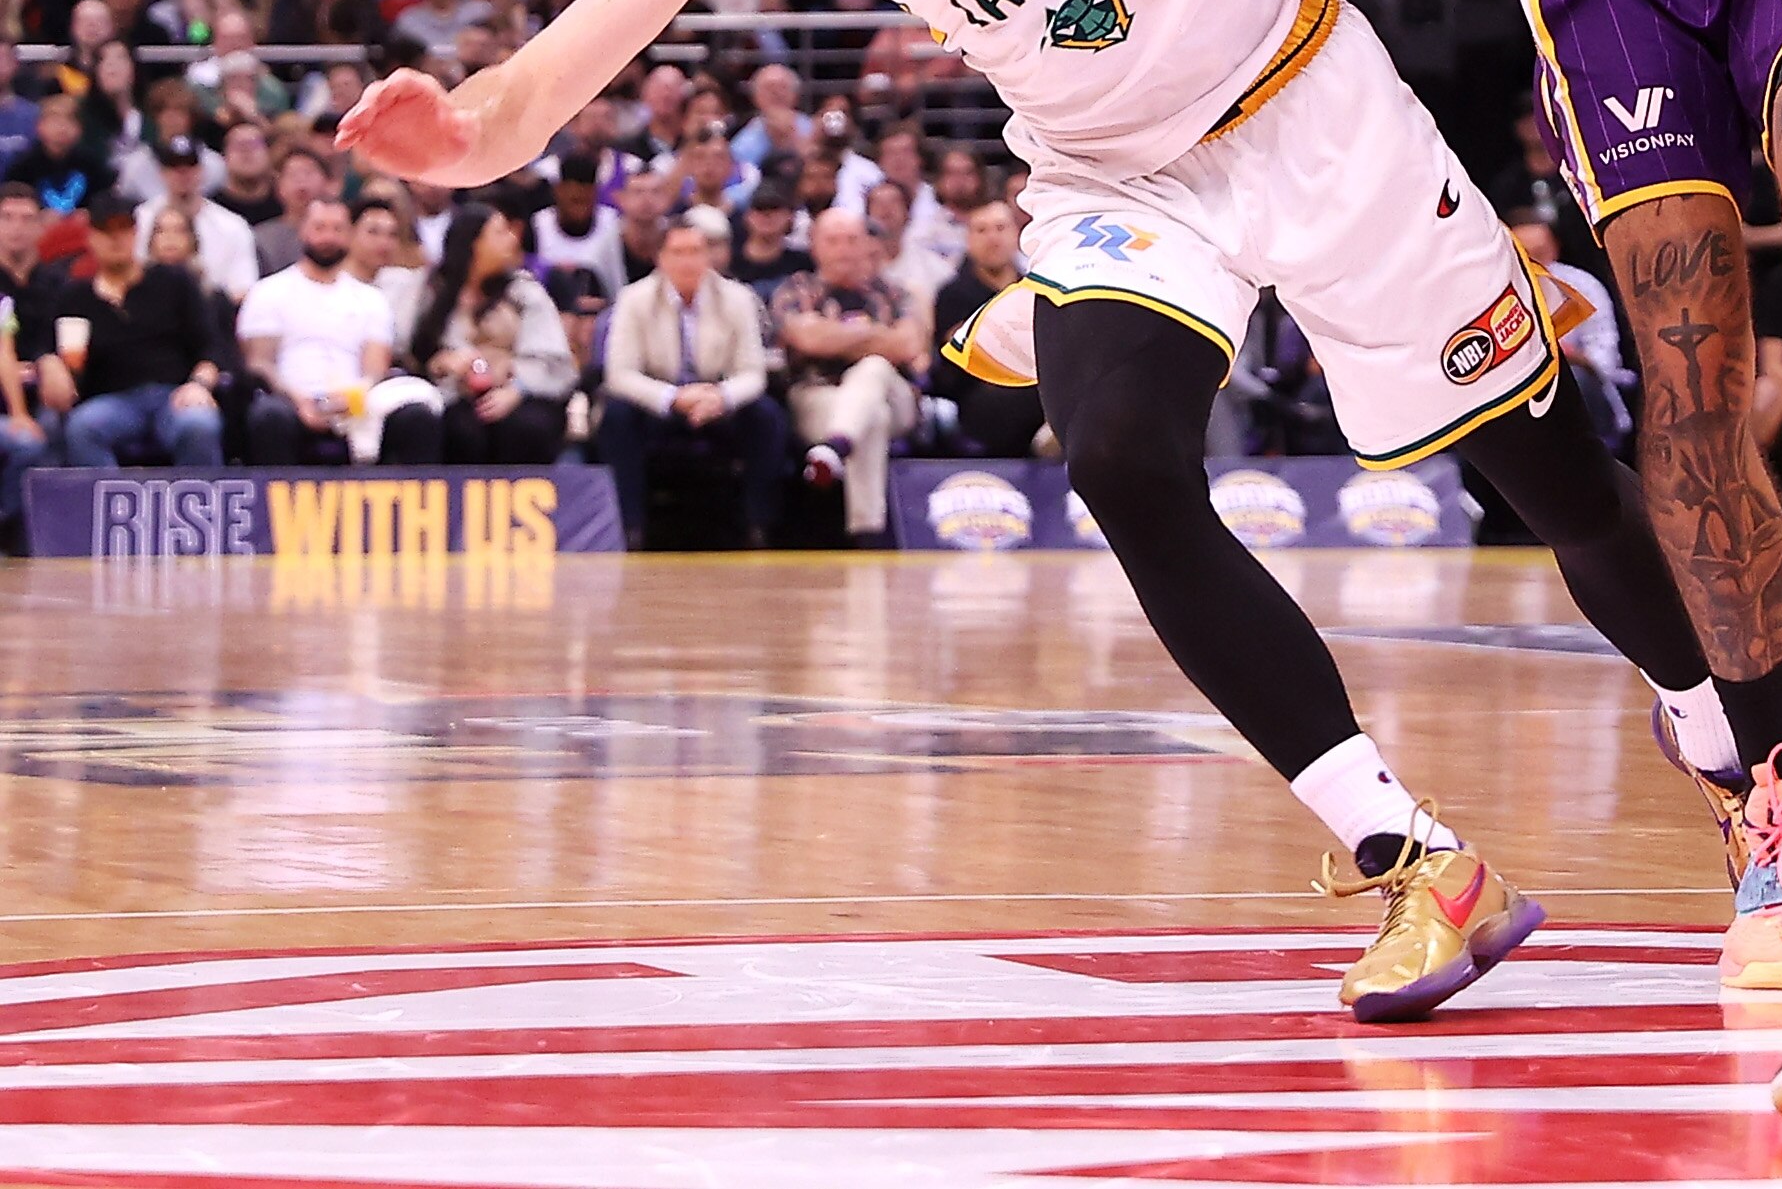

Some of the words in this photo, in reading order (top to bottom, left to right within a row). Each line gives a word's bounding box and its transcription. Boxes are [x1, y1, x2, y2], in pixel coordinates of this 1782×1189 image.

[1599, 132, 1695, 165] VISIONPAY
[1629, 228, 1736, 299] LOVE
[1451, 340, 1486, 374] NBL
[93, 479, 256, 556] RISE
[267, 479, 450, 556] WITH
[462, 478, 558, 556] US
